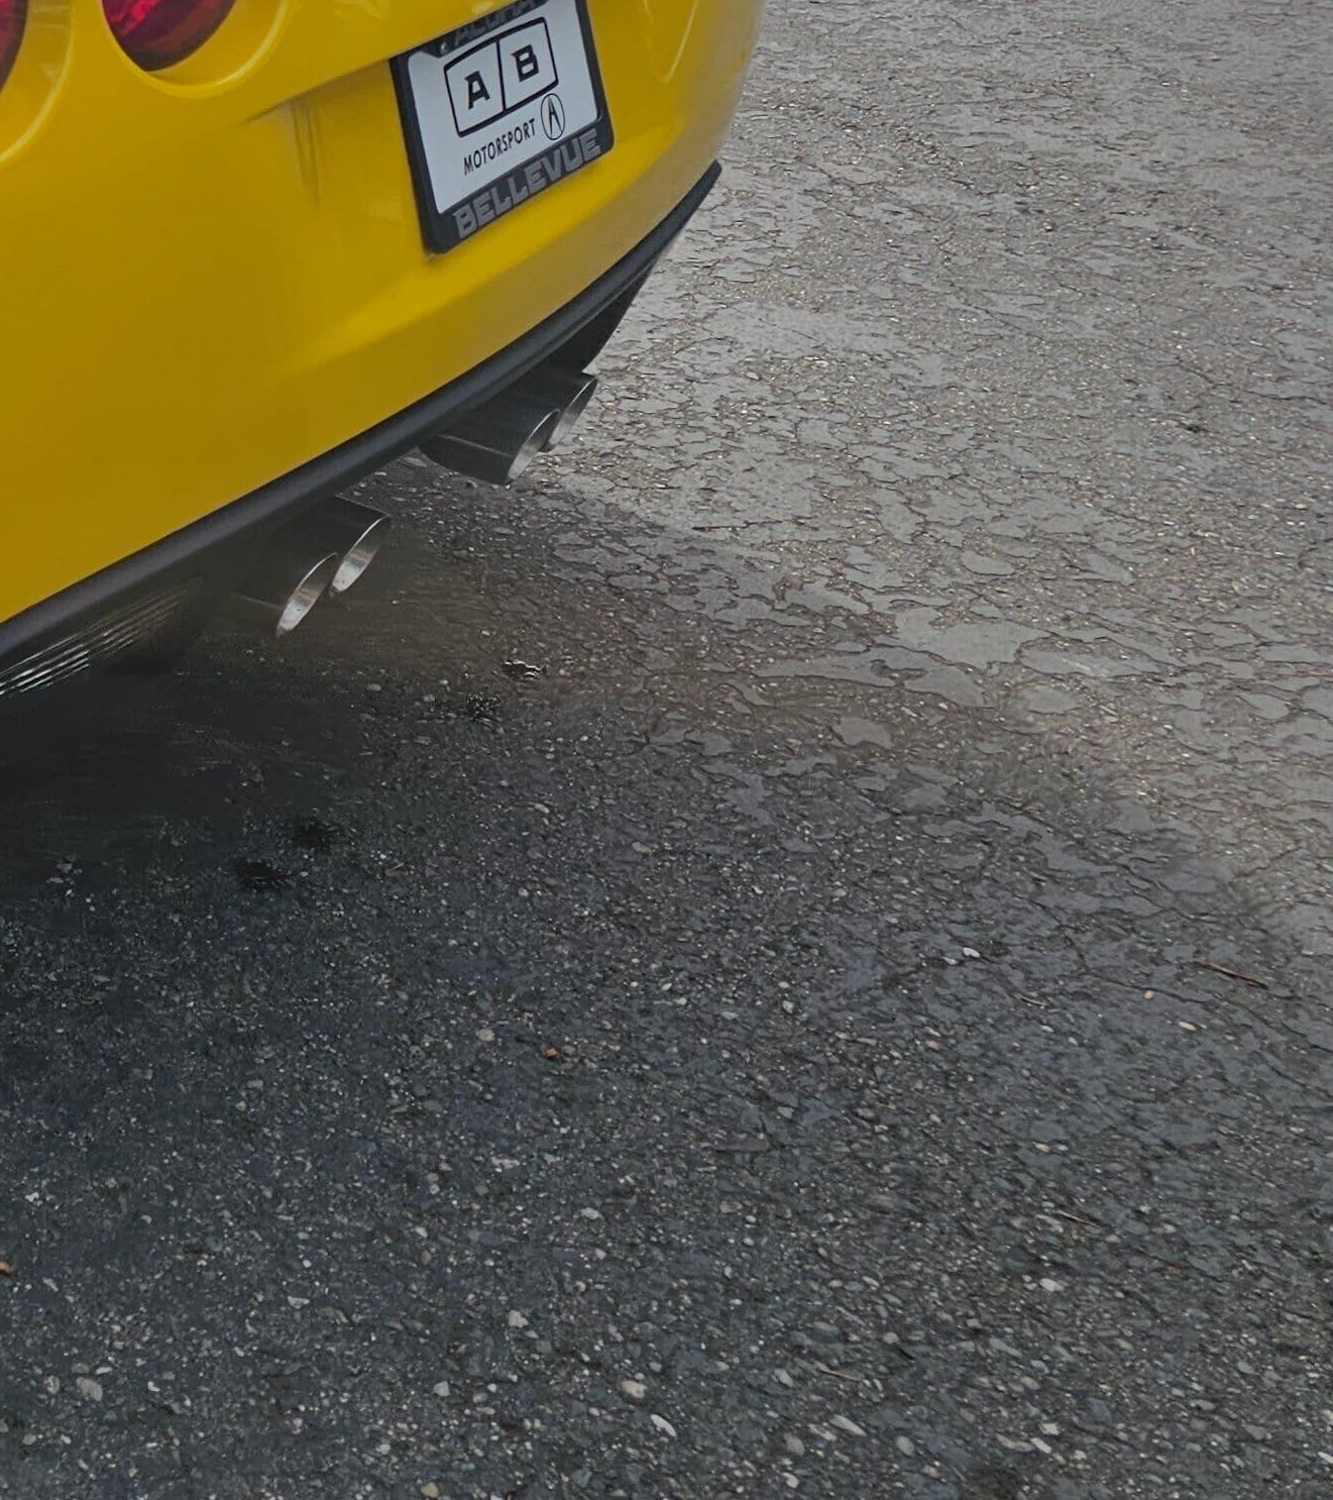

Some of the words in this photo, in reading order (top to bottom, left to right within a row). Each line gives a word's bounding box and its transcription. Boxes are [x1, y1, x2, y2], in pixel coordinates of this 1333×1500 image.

[464, 70, 491, 110] A
[510, 43, 540, 83] B
[463, 118, 537, 176] MOTORSPORT
[452, 127, 602, 239] BELLEVUE
